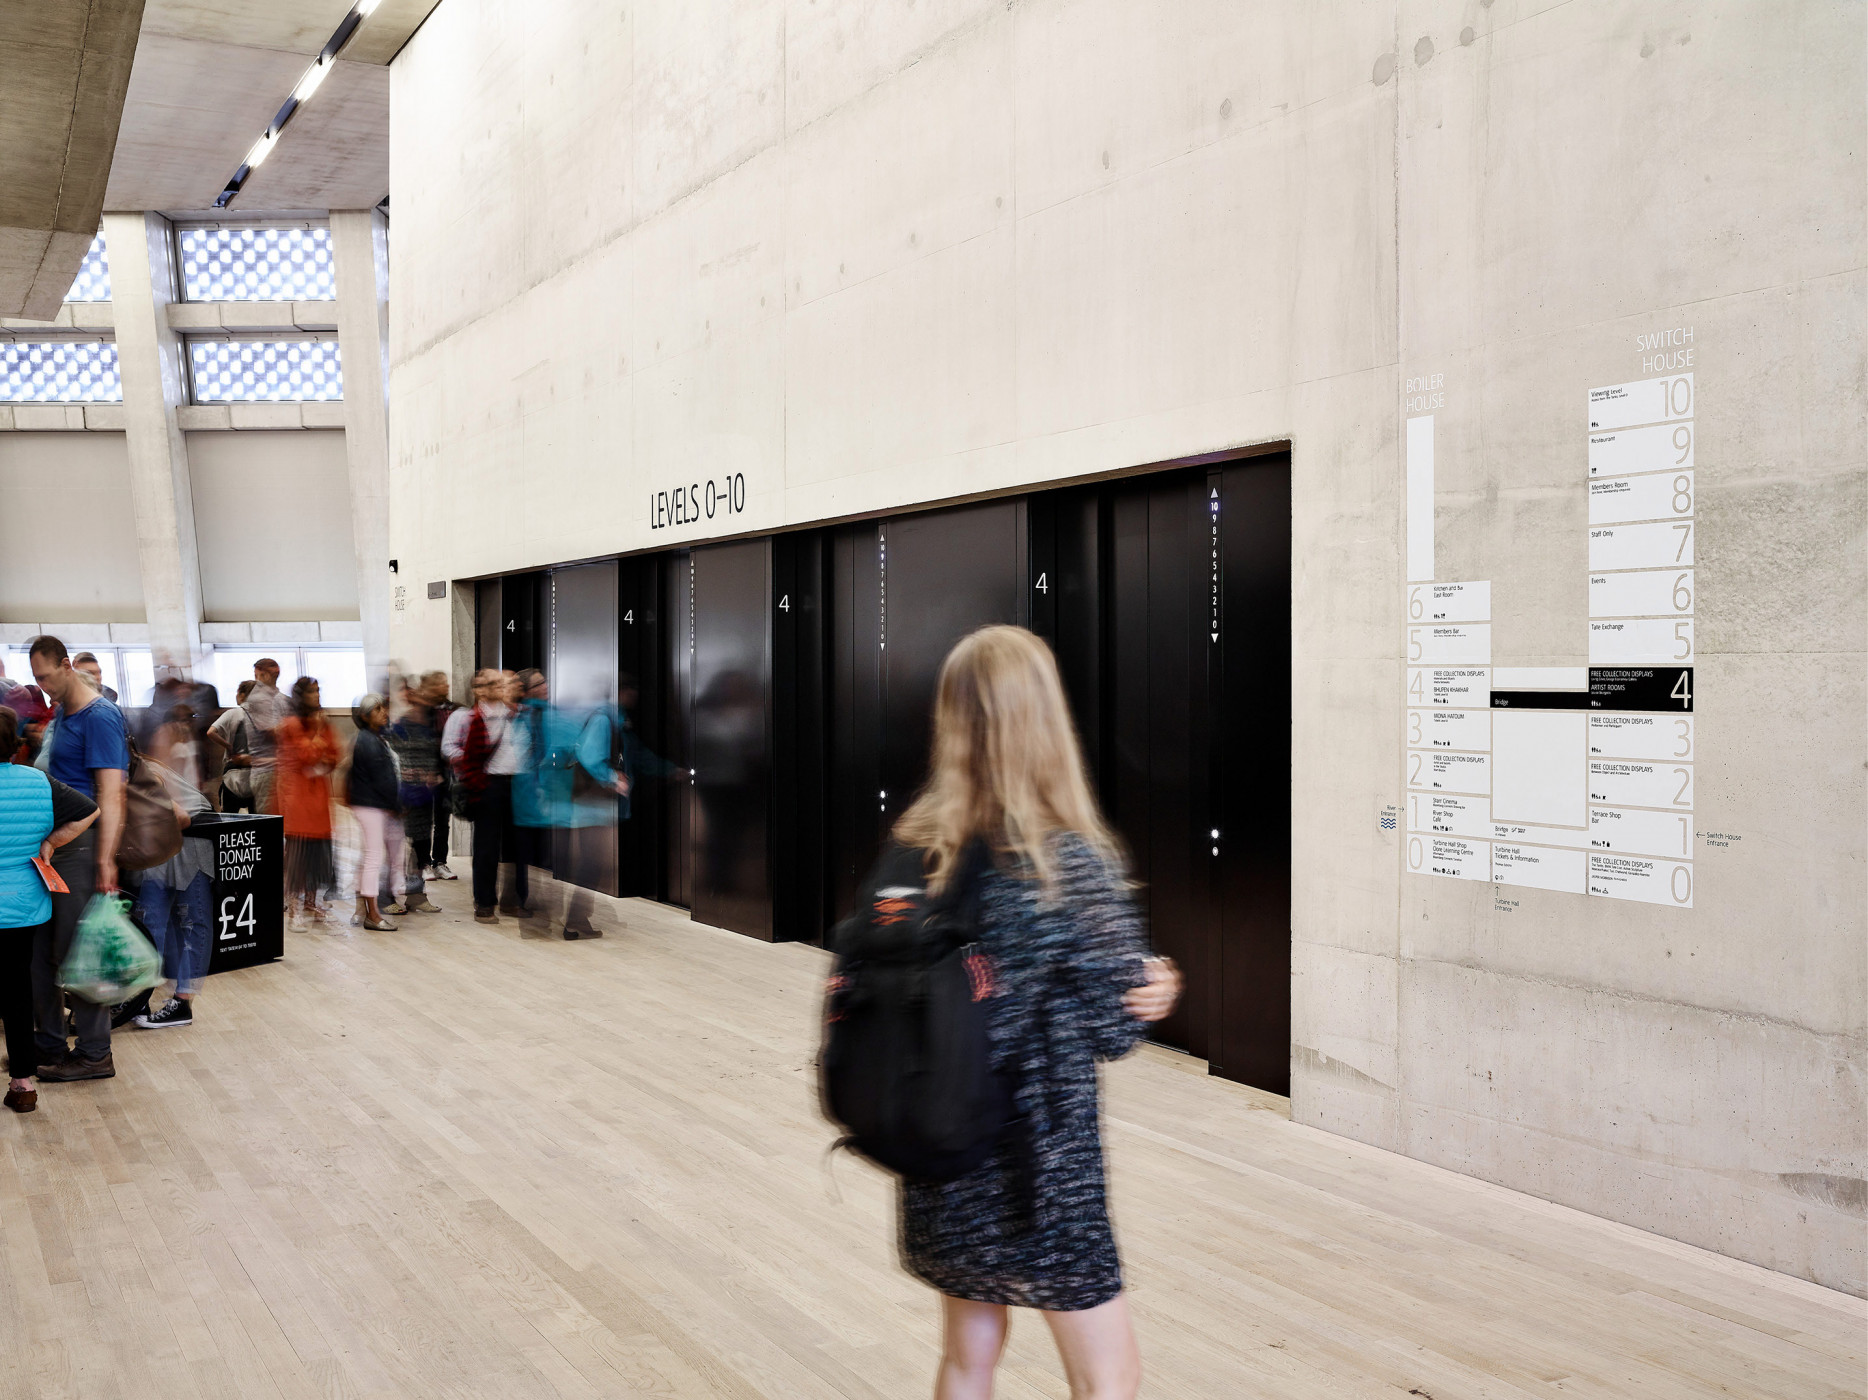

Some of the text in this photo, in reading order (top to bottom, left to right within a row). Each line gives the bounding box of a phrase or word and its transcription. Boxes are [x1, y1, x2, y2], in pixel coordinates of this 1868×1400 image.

[1636, 326, 1694, 352] SWITCH
[1643, 349, 1694, 374] HOUSE
[1406, 374, 1444, 393] BOILER
[1660, 378, 1691, 417] 10
[1406, 393, 1444, 412] HOUSE
[1672, 426, 1691, 465] 9
[652, 484, 699, 529] LEVELS
[1672, 475, 1691, 513] 8
[1672, 524, 1691, 562] 7
[1211, 502, 1218, 629] 10 9 8 7 6 5 4 3 2 1 0
[1035, 572, 1048, 594] 4
[1673, 573, 1691, 611] 6
[624, 610, 634, 624] 4
[779, 594, 790, 612] 4
[1410, 586, 1423, 620] 6
[506, 620, 515, 632] 4
[1674, 622, 1691, 660] 5
[1409, 630, 1422, 661] 5
[1409, 670, 1424, 703] 4
[1670, 670, 1691, 708] 4
[1409, 712, 1422, 744] 3
[1674, 720, 1691, 757] 3
[1410, 754, 1422, 786] 2
[1673, 768, 1690, 806] 2
[1411, 796, 1417, 828] 1
[220, 831, 256, 848] PLEASE
[1443, 847, 1460, 855] Learning
[1678, 818, 1687, 855] 1
[219, 847, 261, 865] DONATE
[1409, 837, 1423, 870] 0
[1514, 855, 1539, 863] Information
[1603, 858, 1630, 867] COLLECTION
[1632, 861, 1653, 869] DISPLAYS
[219, 864, 254, 881] TODAY
[1671, 866, 1691, 903] 0
[219, 893, 256, 940] £4
